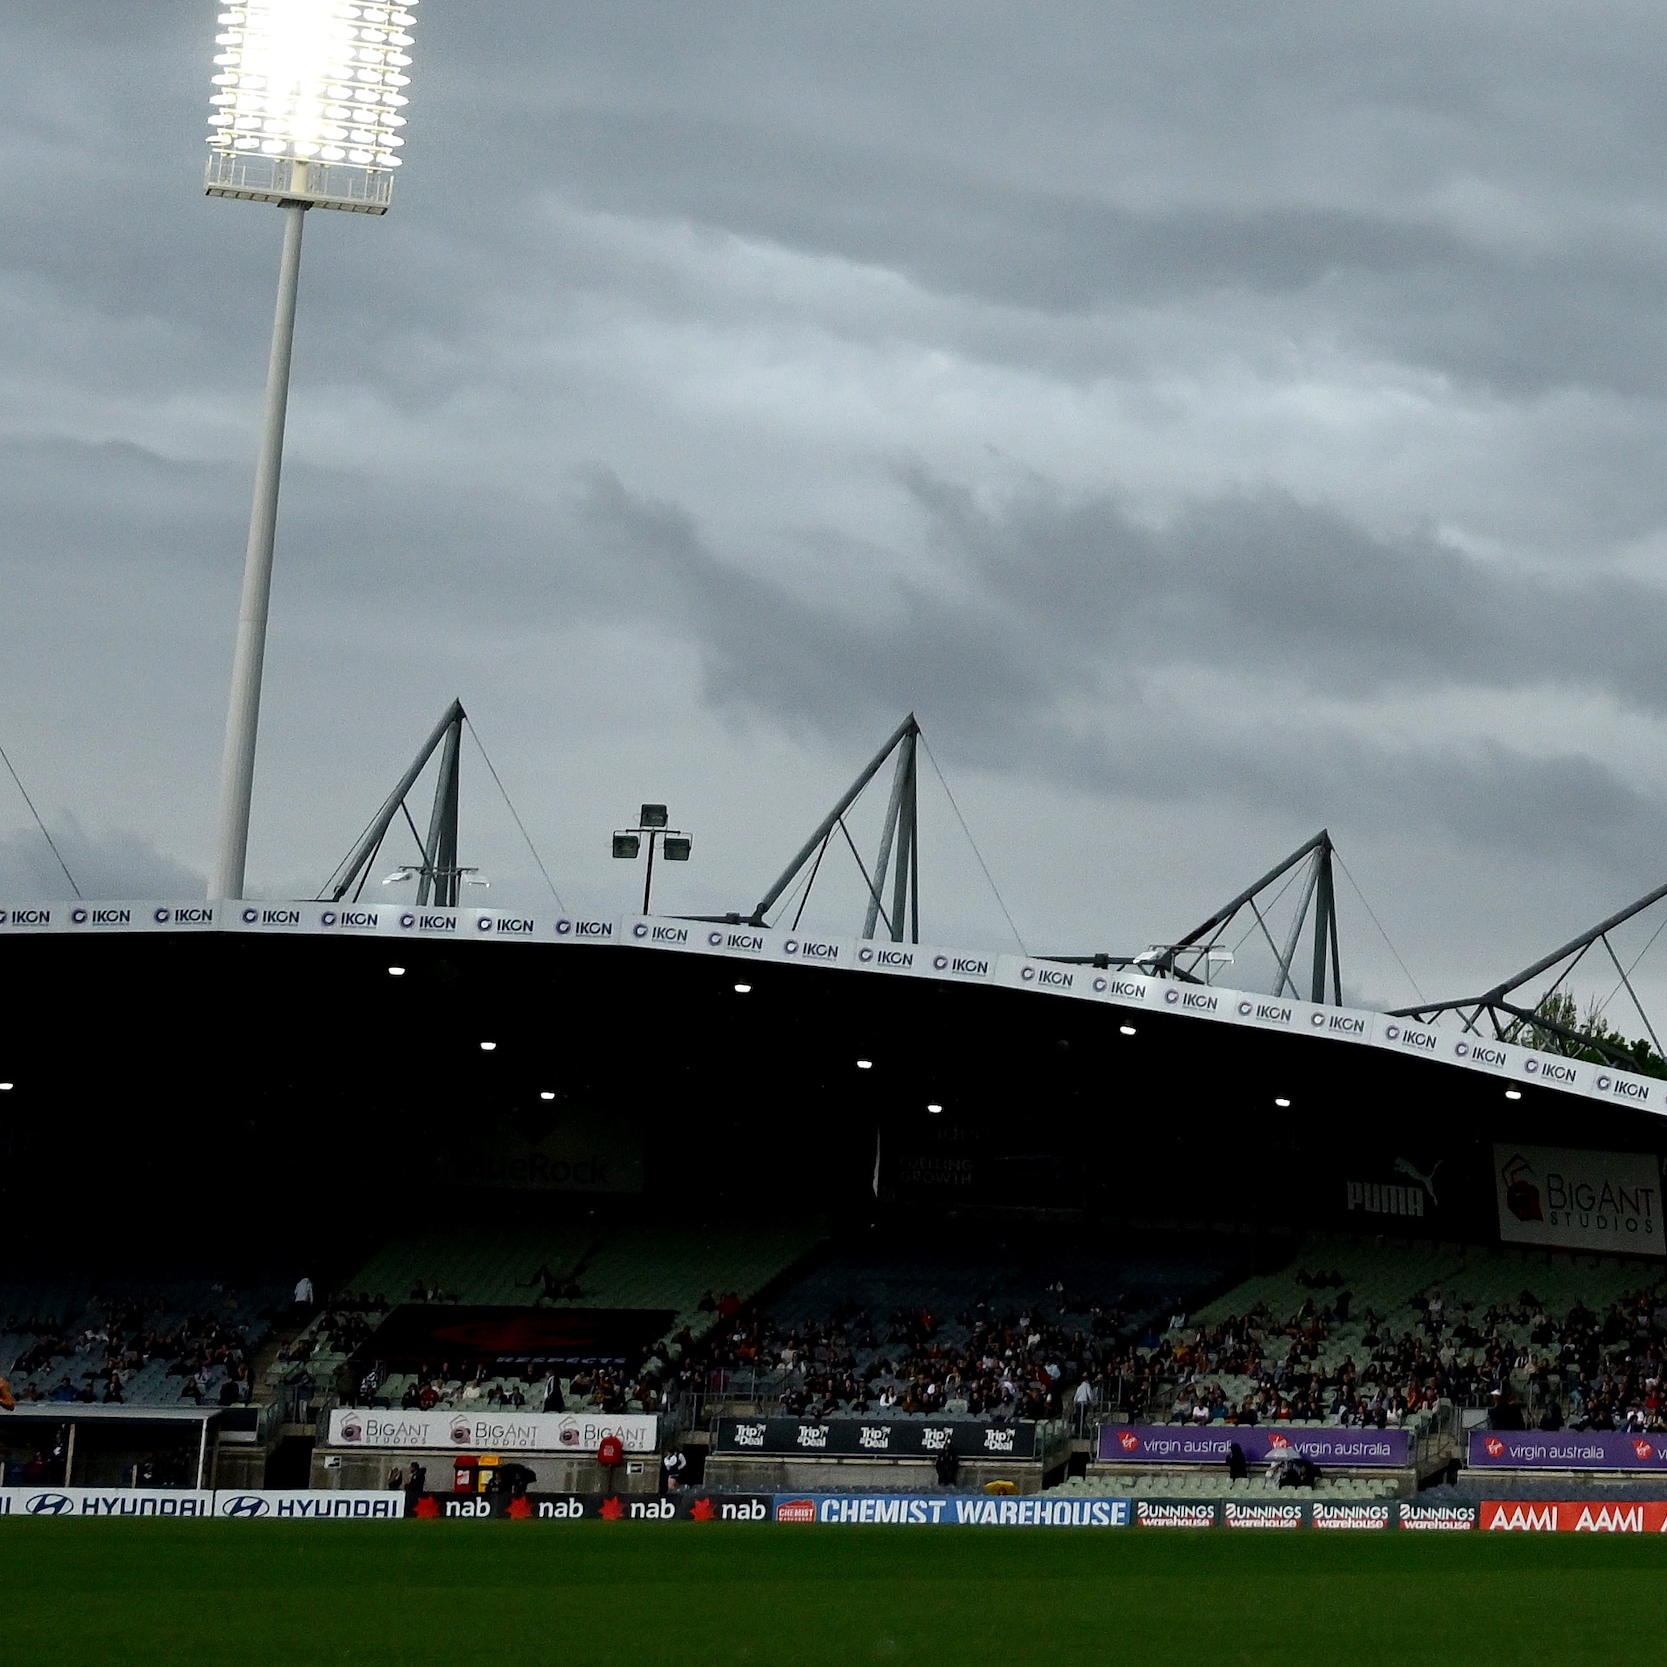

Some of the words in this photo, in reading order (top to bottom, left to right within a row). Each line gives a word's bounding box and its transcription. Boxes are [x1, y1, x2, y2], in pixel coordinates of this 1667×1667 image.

[12, 911, 49, 923] IKON
[93, 910, 130, 922] IKON
[175, 910, 212, 921] IKON
[263, 911, 299, 922] IKON
[341, 913, 377, 925] IKON
[420, 916, 456, 928] IKON
[498, 919, 533, 931] IKON
[576, 922, 612, 934] IKON
[653, 927, 687, 941] IKON
[728, 935, 762, 949] IKON
[803, 943, 838, 957] IKON
[878, 951, 913, 965] IKON
[953, 959, 988, 973] IKON
[1039, 970, 1073, 986] IKON
[1111, 981, 1145, 997] IKON
[1183, 993, 1217, 1009] IKON
[1257, 1005, 1291, 1021] IKON
[1330, 1016, 1364, 1032] IKON
[1403, 1030, 1436, 1048] IKON
[1473, 1047, 1506, 1065] IKON
[1542, 1064, 1576, 1082] IKON
[1615, 1081, 1648, 1098] IKON
[1347, 1181, 1424, 1216] PUMA
[1550, 1211, 1653, 1233] STUDIOS
[736, 1424, 757, 1437] Trip
[798, 1426, 820, 1438] Trip
[860, 1427, 881, 1440] Trip
[923, 1428, 944, 1441] Trip
[984, 1429, 1006, 1442] Trip
[1143, 1438, 1180, 1455] virgin
[1294, 1440, 1331, 1456] virgin
[1334, 1441, 1391, 1455] australia
[1509, 1444, 1545, 1459] virgin
[1548, 1444, 1604, 1458] australia
[82, 1498, 205, 1517] HYUNDAI
[278, 1499, 398, 1519] HYUNDAI
[446, 1497, 490, 1517] nab
[539, 1498, 583, 1517] nab
[630, 1498, 675, 1519] nab
[722, 1499, 765, 1519] nab
[779, 1507, 815, 1517] CHEMIST
[822, 1500, 946, 1522] CHEMIST
[956, 1501, 1126, 1525] WAREHOUSE
[1137, 1503, 1214, 1519] BUNNINGS
[1226, 1503, 1301, 1520] BUNNINGS
[1313, 1504, 1388, 1520] BUNNINGS
[1400, 1504, 1475, 1522] BUNNINGS
[1490, 1506, 1557, 1530] AAMI
[1575, 1505, 1643, 1529] AAMI
